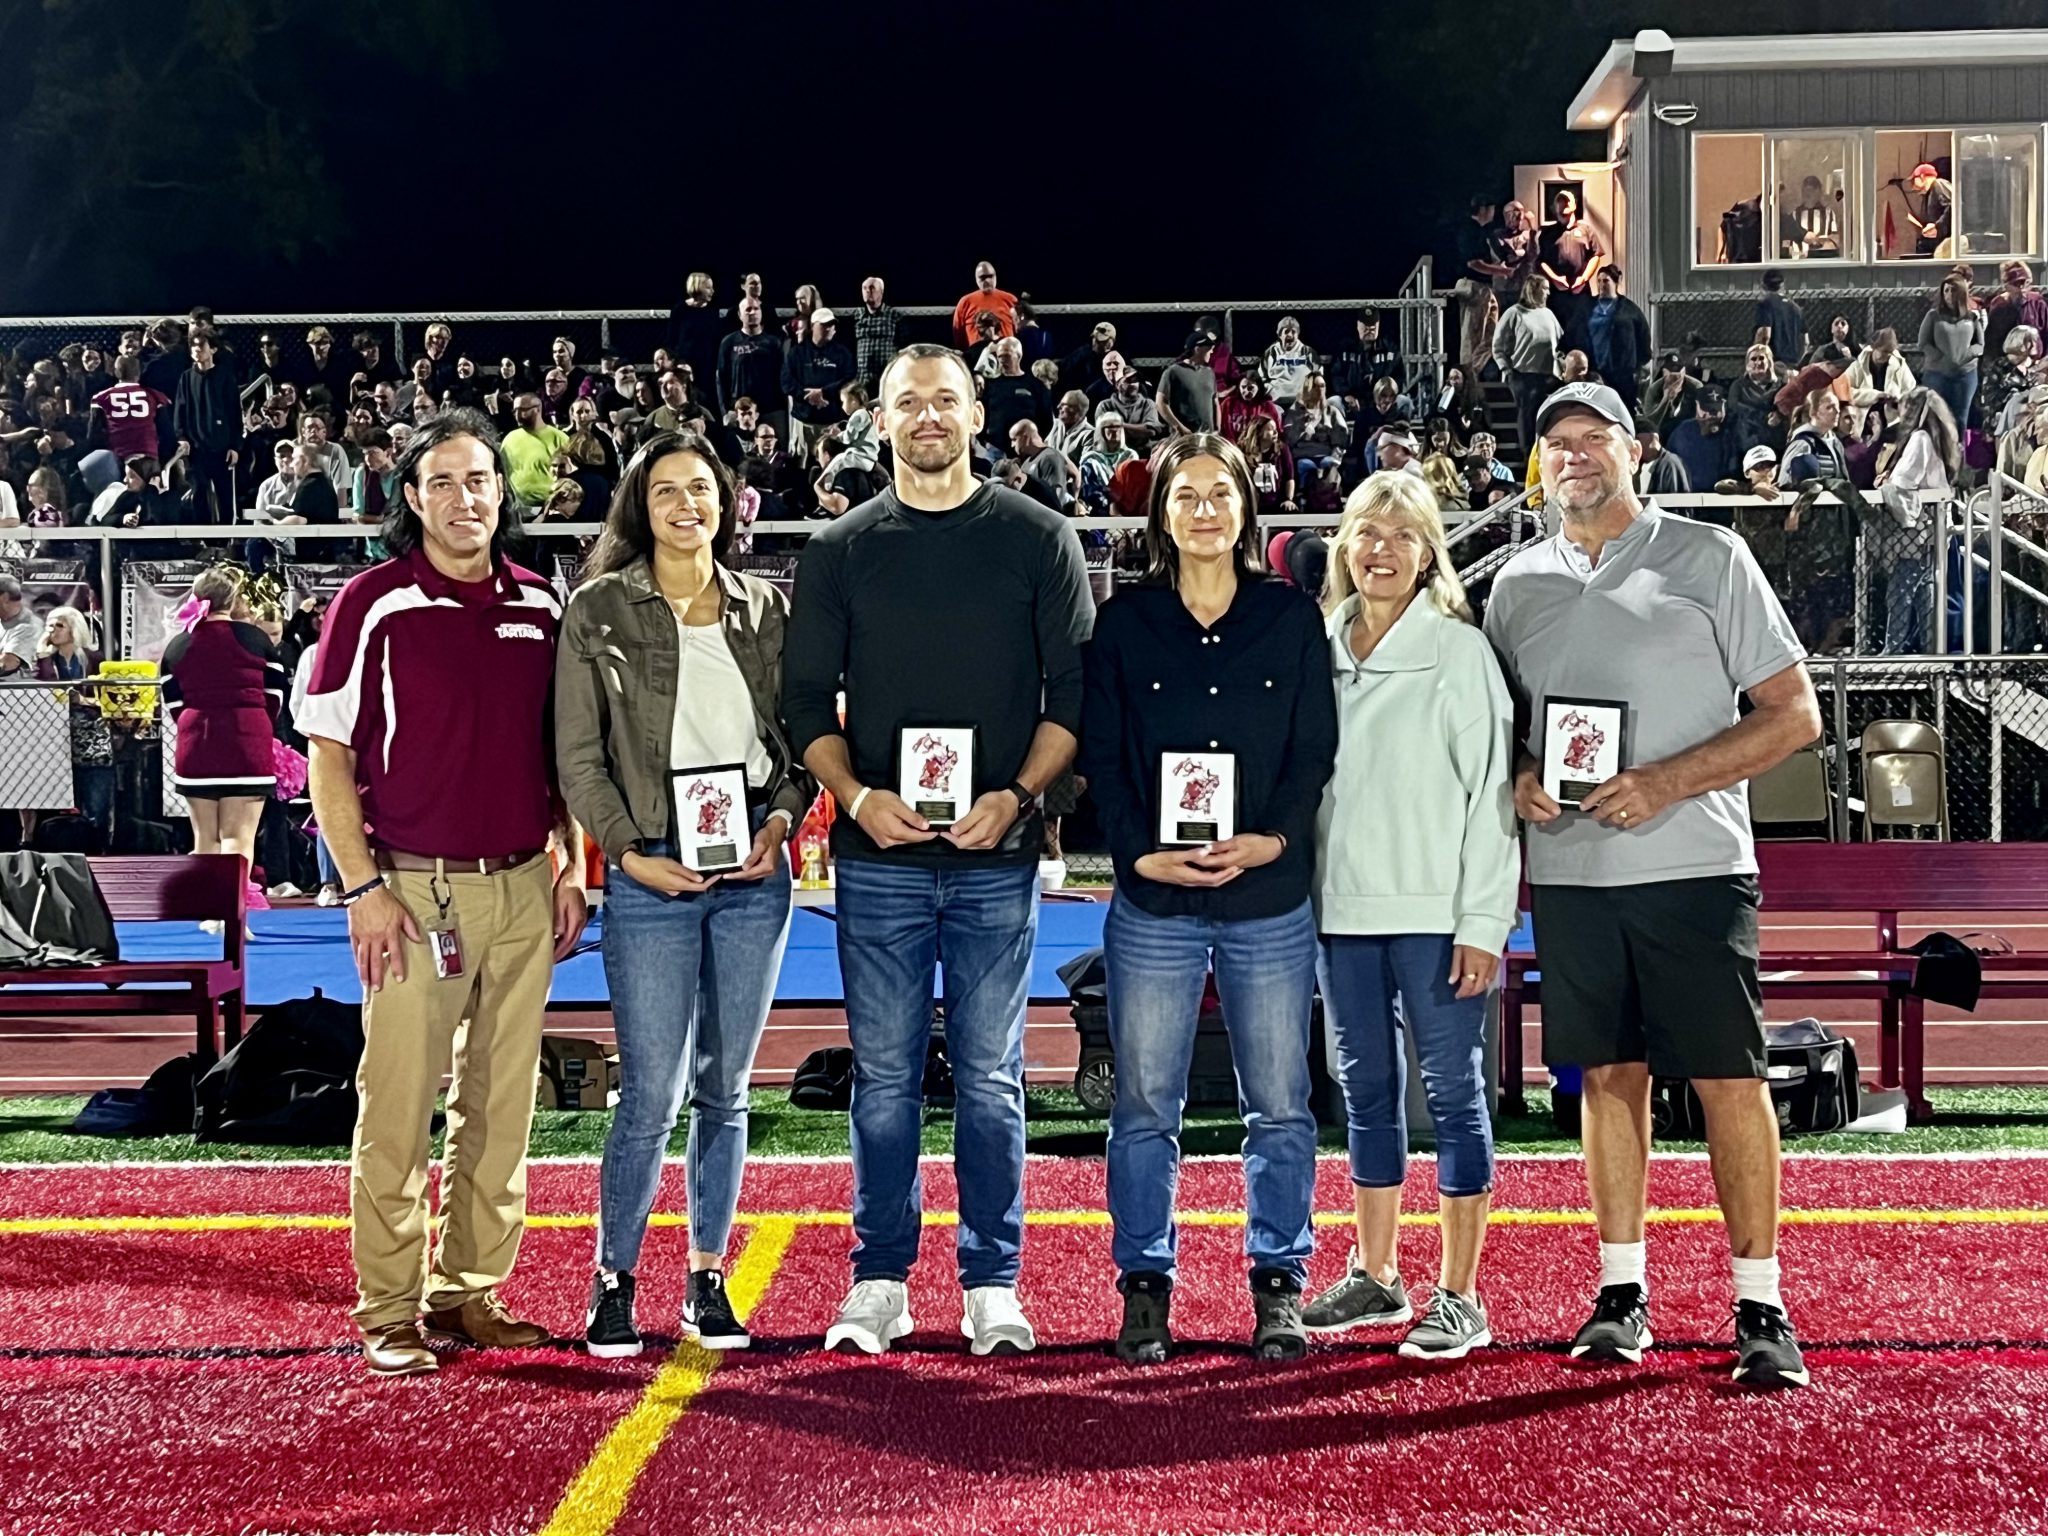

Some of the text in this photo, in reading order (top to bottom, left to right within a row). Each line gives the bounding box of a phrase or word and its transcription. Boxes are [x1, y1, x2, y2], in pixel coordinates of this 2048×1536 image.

[110, 391, 149, 418] 55
[741, 568, 786, 577] FOOTBALL
[494, 627, 545, 640] TARTANS
